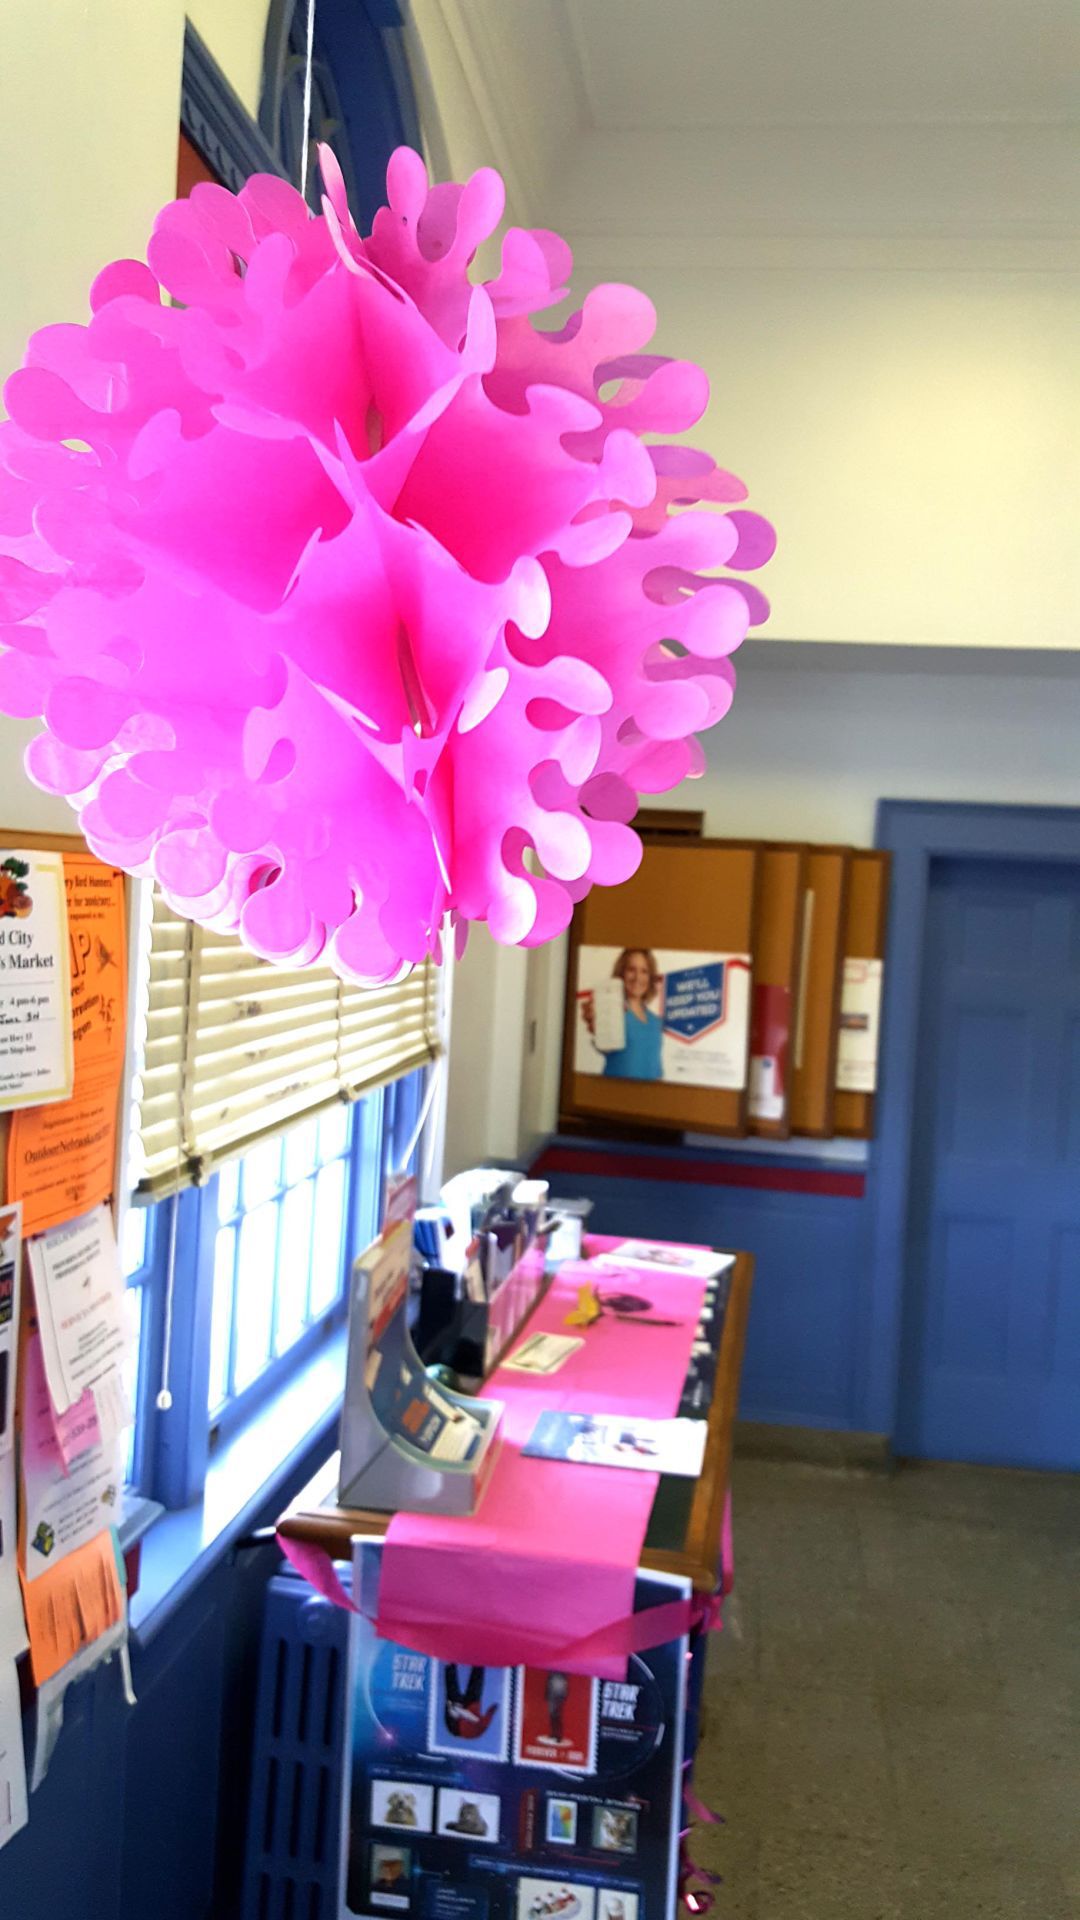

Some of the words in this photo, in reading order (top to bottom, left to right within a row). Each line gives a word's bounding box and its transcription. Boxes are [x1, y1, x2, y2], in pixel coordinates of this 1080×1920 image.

[9, 929, 34, 949] City
[10, 953, 54, 969] Market
[677, 978, 709, 992] WE'LL
[667, 993, 693, 1006] KEEP
[696, 989, 720, 1002] YOU
[667, 1004, 717, 1019] UPDATED
[393, 1654, 427, 1673] STAR
[392, 1671, 424, 1691] TREK
[602, 1682, 640, 1702] STAR
[601, 1700, 636, 1720] TREK
